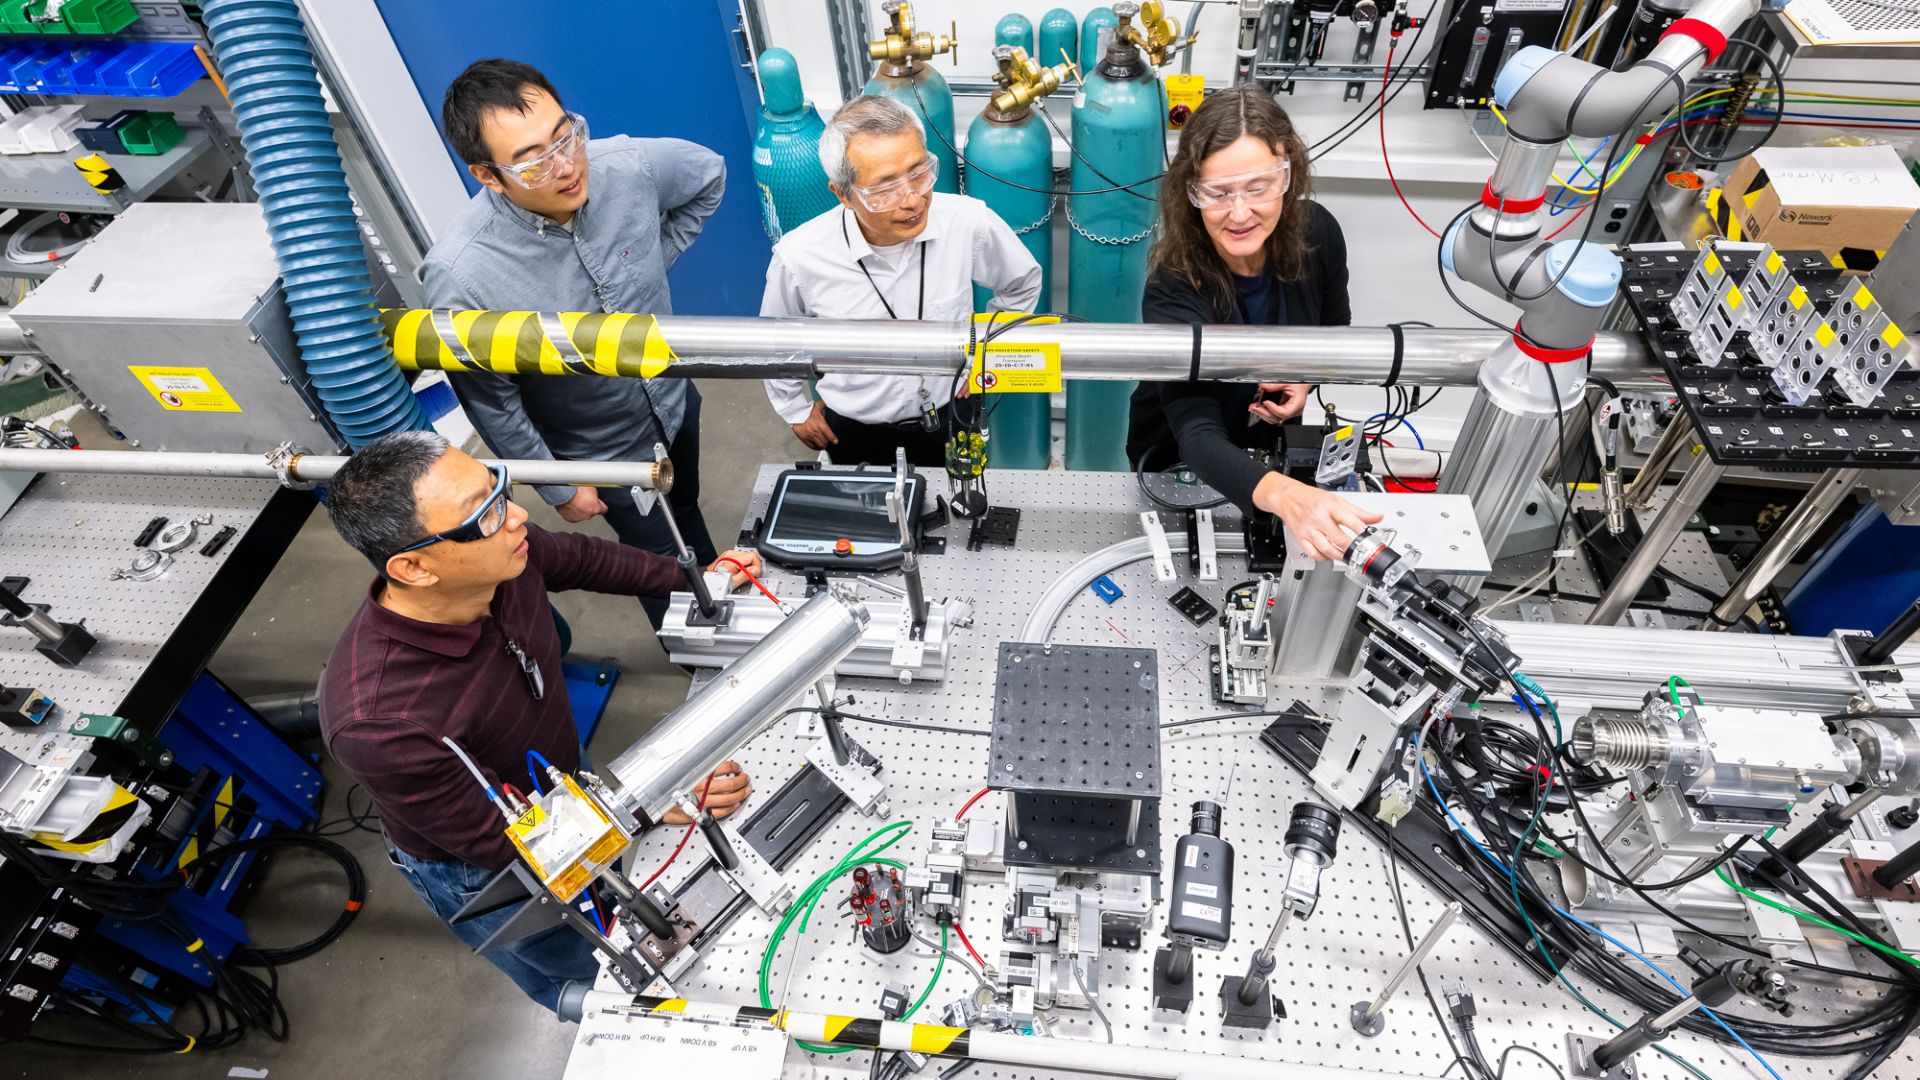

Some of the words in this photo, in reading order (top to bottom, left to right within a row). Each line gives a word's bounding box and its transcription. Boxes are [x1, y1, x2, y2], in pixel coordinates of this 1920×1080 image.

[1798, 213, 1833, 221] Newark
[621, 1033, 631, 1041] KB
[680, 1037, 701, 1046] DOWN
[707, 1039, 717, 1047] KB
